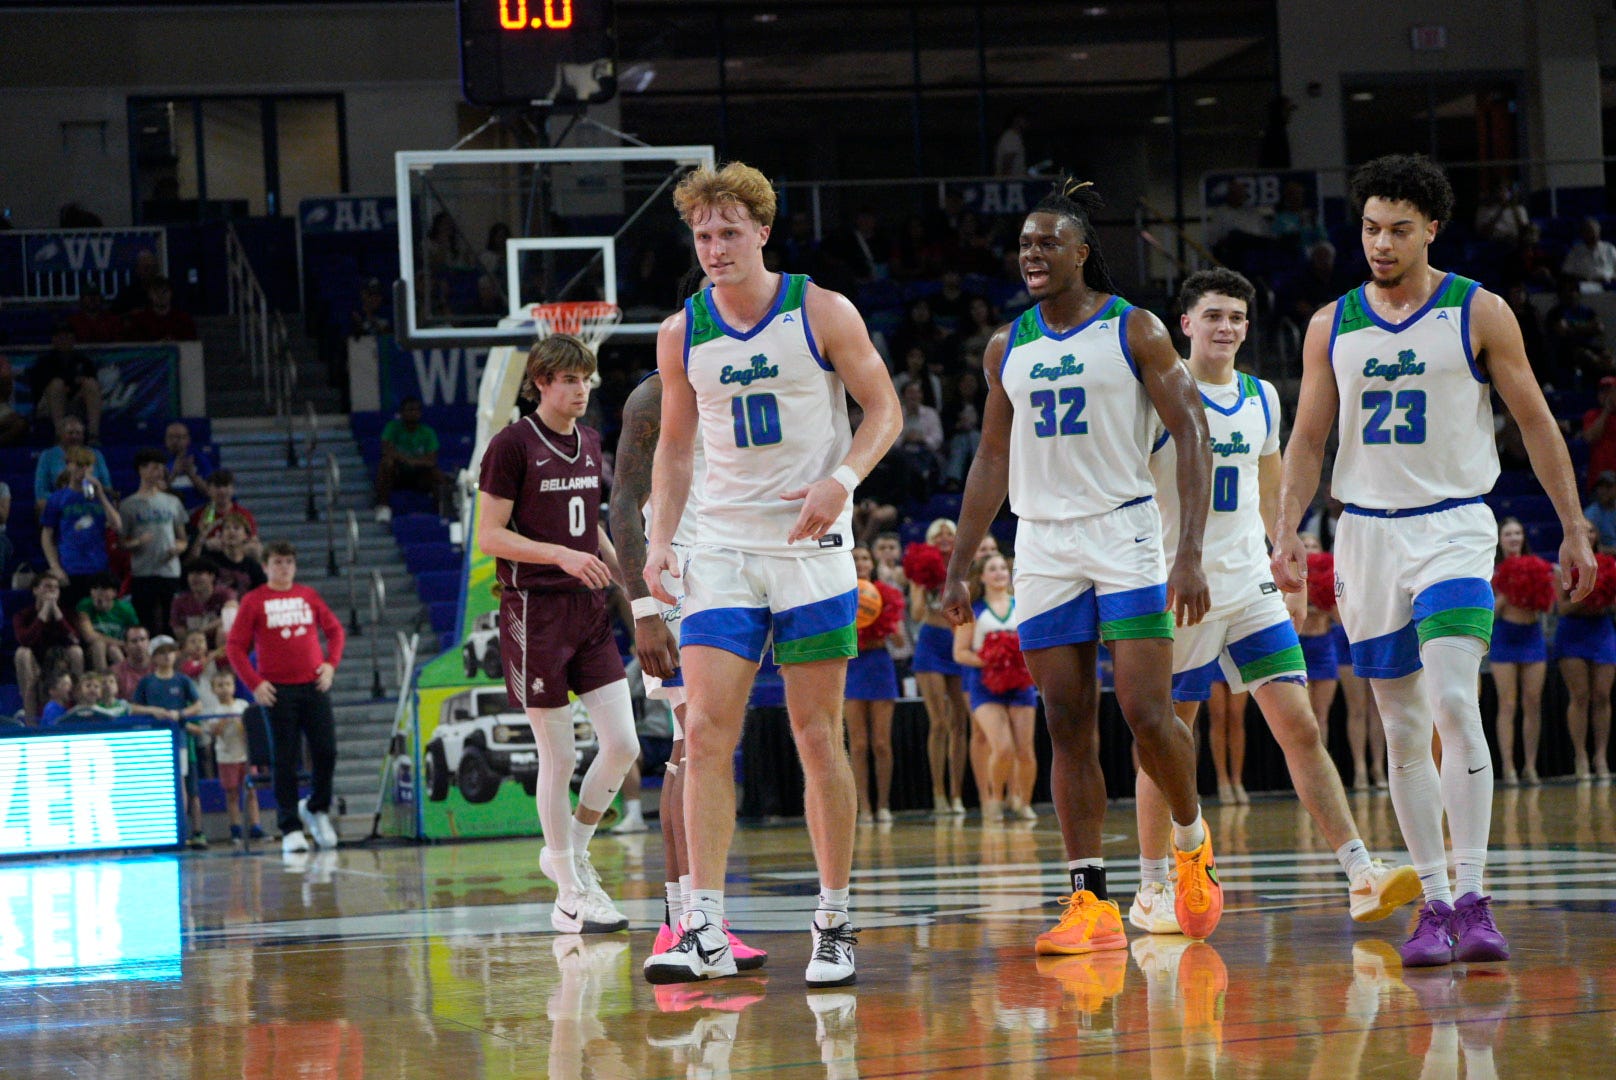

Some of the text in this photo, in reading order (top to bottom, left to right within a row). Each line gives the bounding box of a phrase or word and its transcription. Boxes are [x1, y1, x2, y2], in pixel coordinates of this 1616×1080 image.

[333, 200, 381, 231] AA
[719, 354, 779, 386] Eagles
[1029, 354, 1085, 381] Eagles
[1363, 349, 1426, 381] Eagles
[731, 392, 783, 448] 10
[1029, 386, 1089, 438] 32
[1361, 389, 1427, 445] 23
[540, 475, 599, 492] BELLARMINE
[1213, 466, 1239, 512] 0
[569, 496, 586, 537] 0
